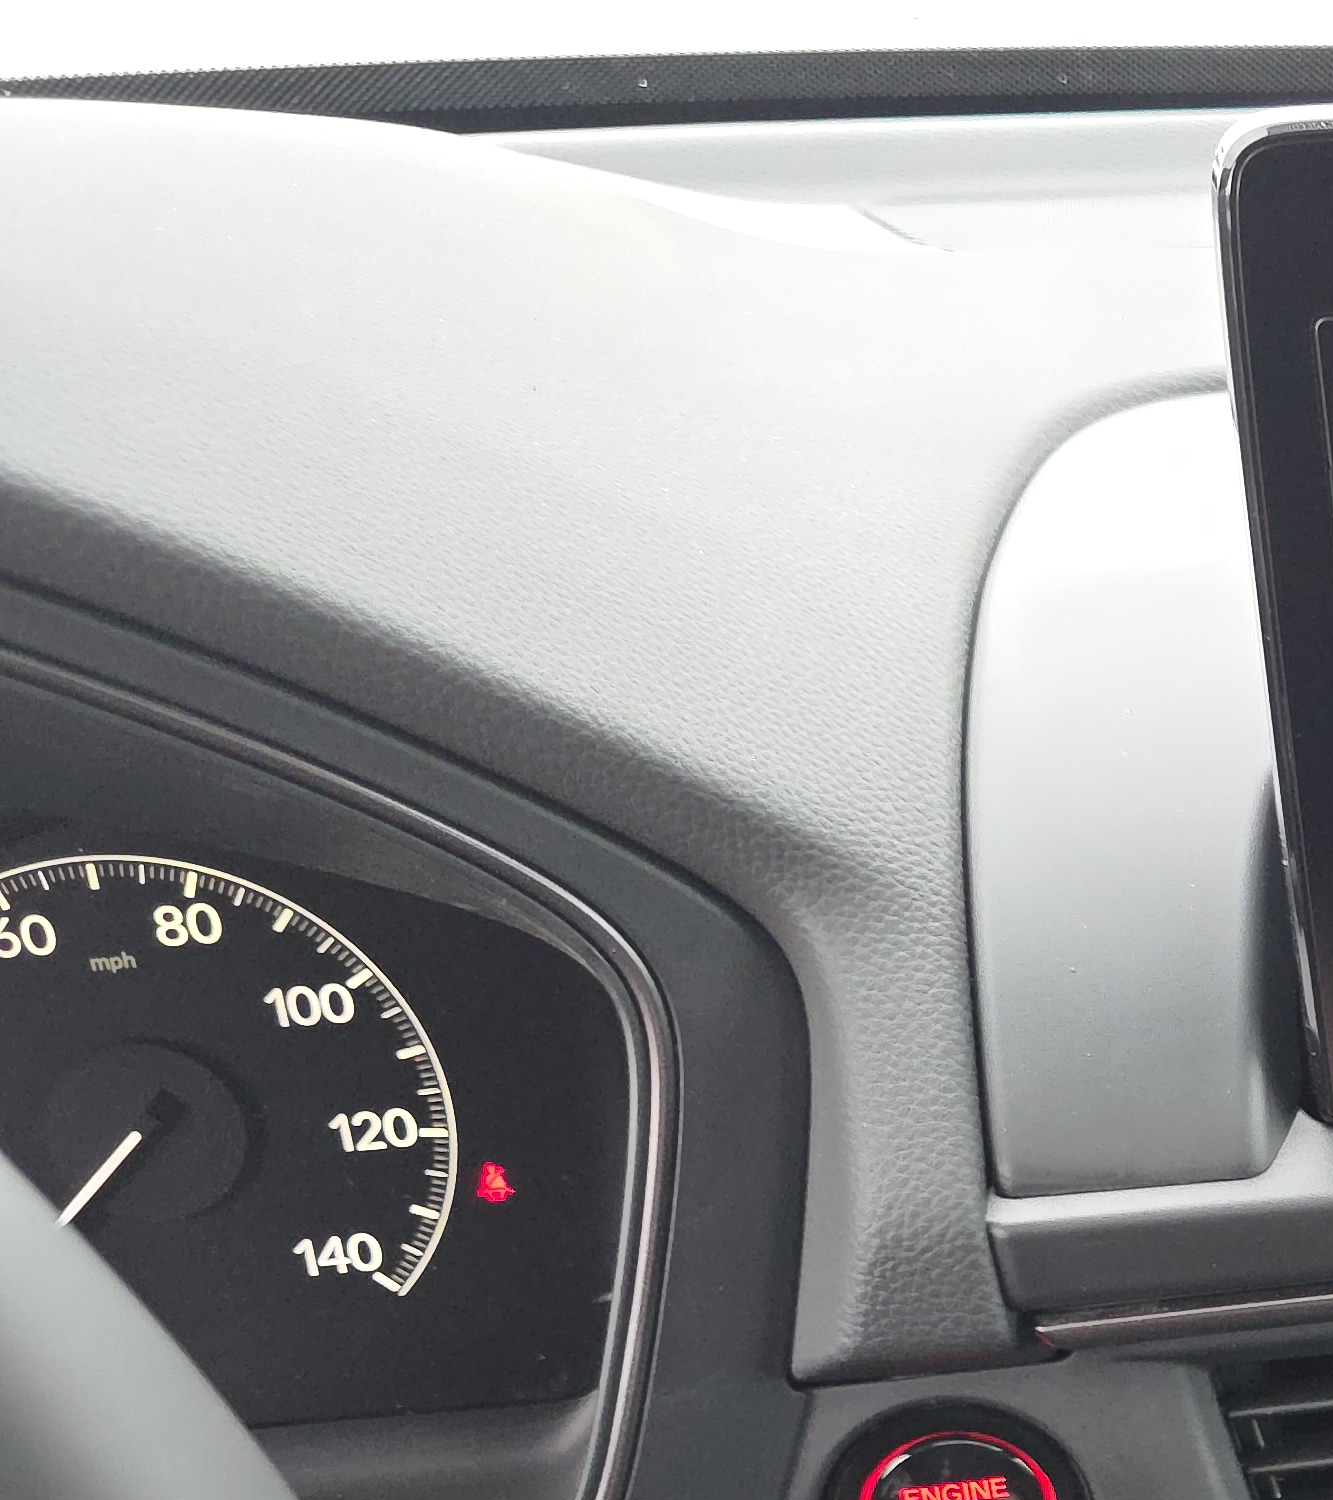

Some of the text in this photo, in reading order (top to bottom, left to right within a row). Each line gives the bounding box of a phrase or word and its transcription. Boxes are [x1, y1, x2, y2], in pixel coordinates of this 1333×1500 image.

[0, 914, 57, 959] 60
[152, 902, 223, 947] 80
[89, 951, 138, 974] mph
[263, 982, 356, 1028] 100
[327, 1107, 419, 1153] 120
[292, 1232, 385, 1278] 140
